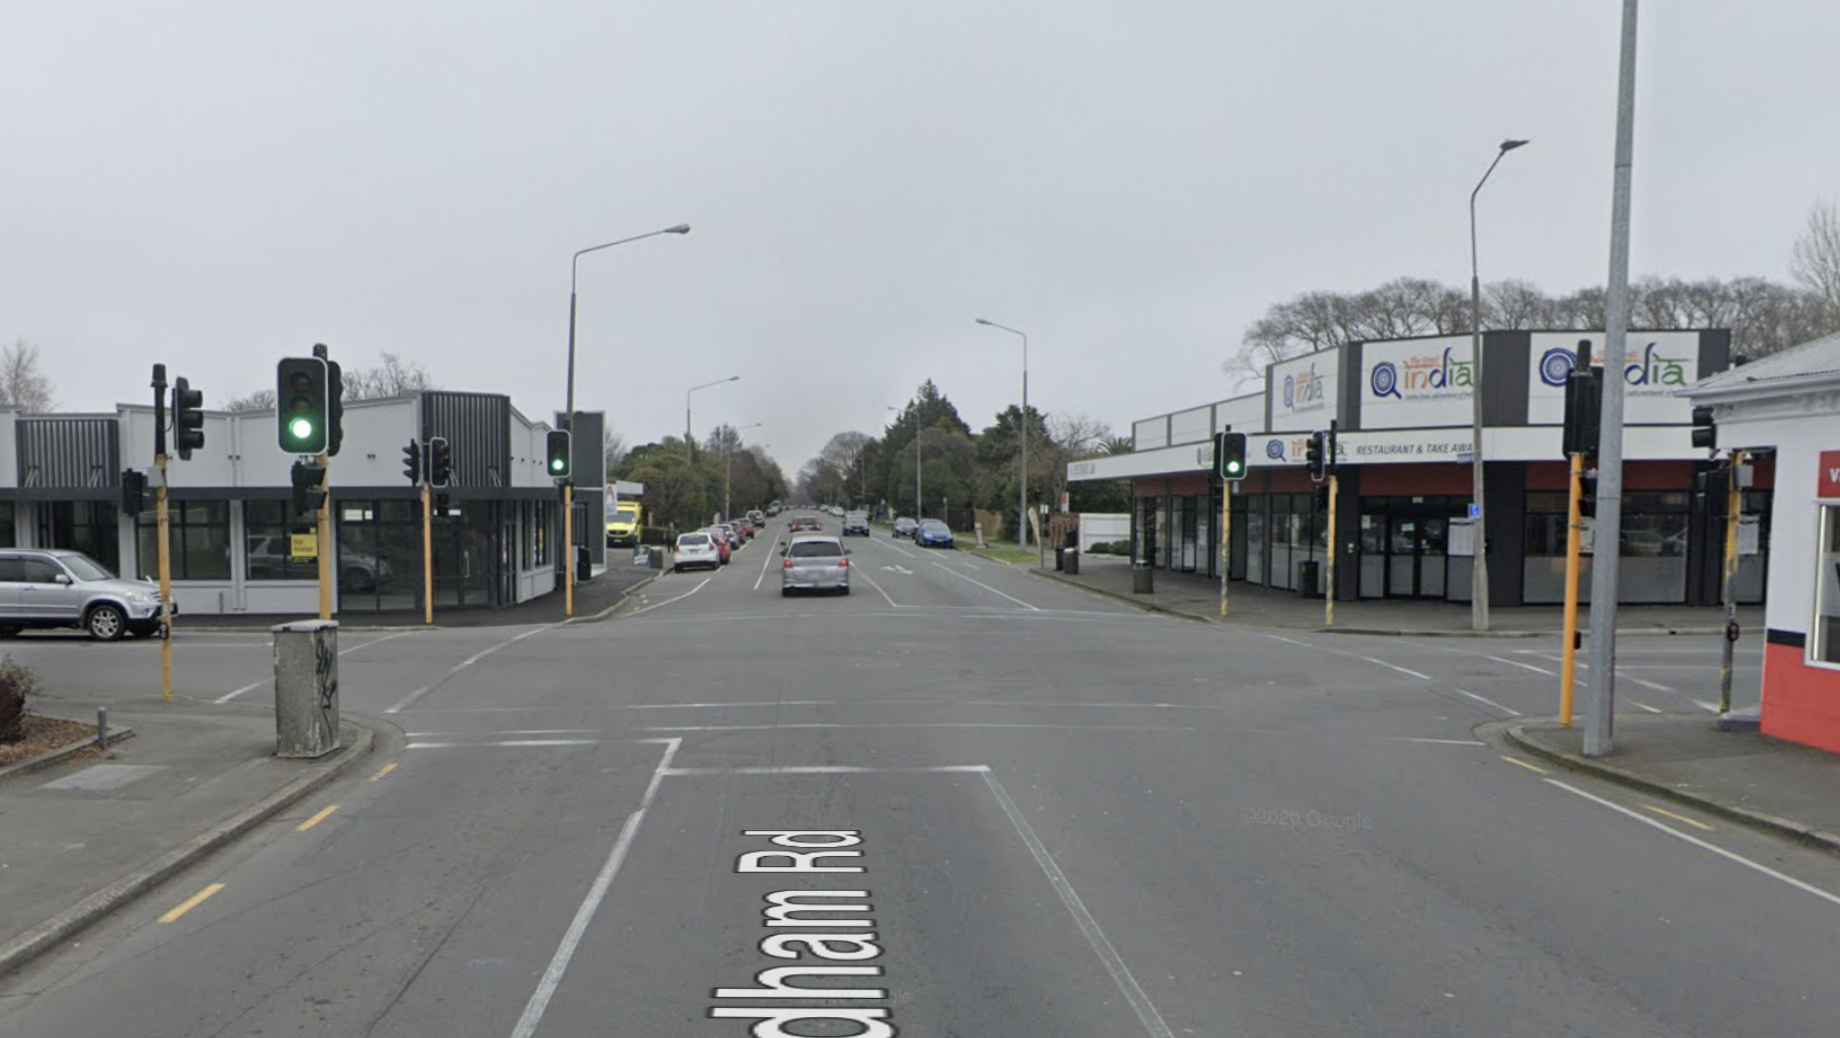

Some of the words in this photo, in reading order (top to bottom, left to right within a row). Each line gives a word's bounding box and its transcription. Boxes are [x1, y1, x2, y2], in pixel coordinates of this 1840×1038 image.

[1356, 444, 1414, 456] RESTAURANT
[1416, 444, 1424, 455] &
[1426, 443, 1450, 454] TAKE
